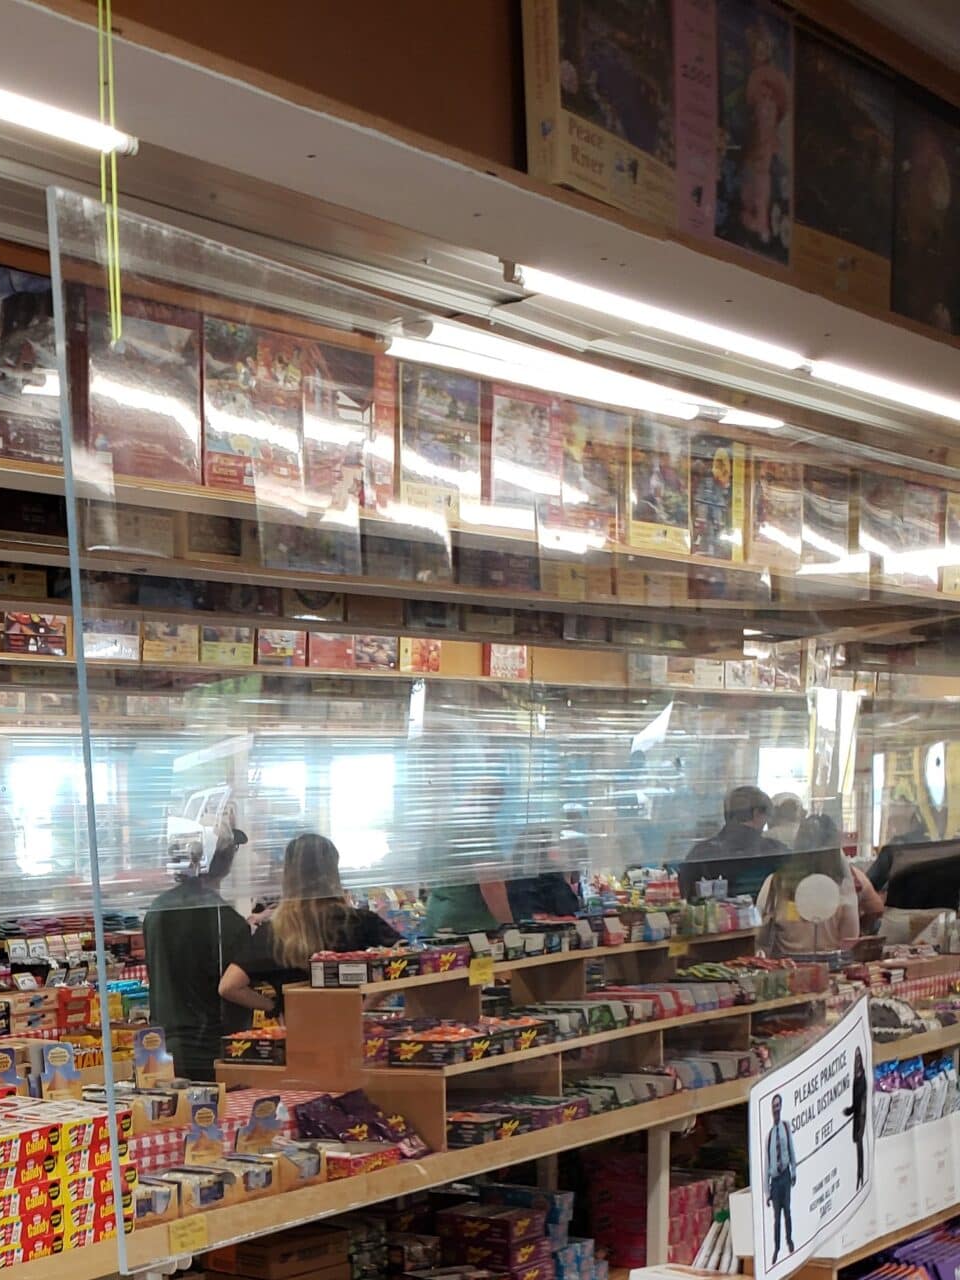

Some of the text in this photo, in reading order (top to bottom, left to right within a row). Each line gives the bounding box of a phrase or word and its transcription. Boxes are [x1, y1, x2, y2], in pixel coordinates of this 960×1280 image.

[794, 1051, 846, 1106] PLEASE PRACTICE
[792, 1074, 850, 1133] SOCIAL DISTANCING
[821, 1119, 833, 1139] FEET
[26, 1191, 48, 1209] Candy
